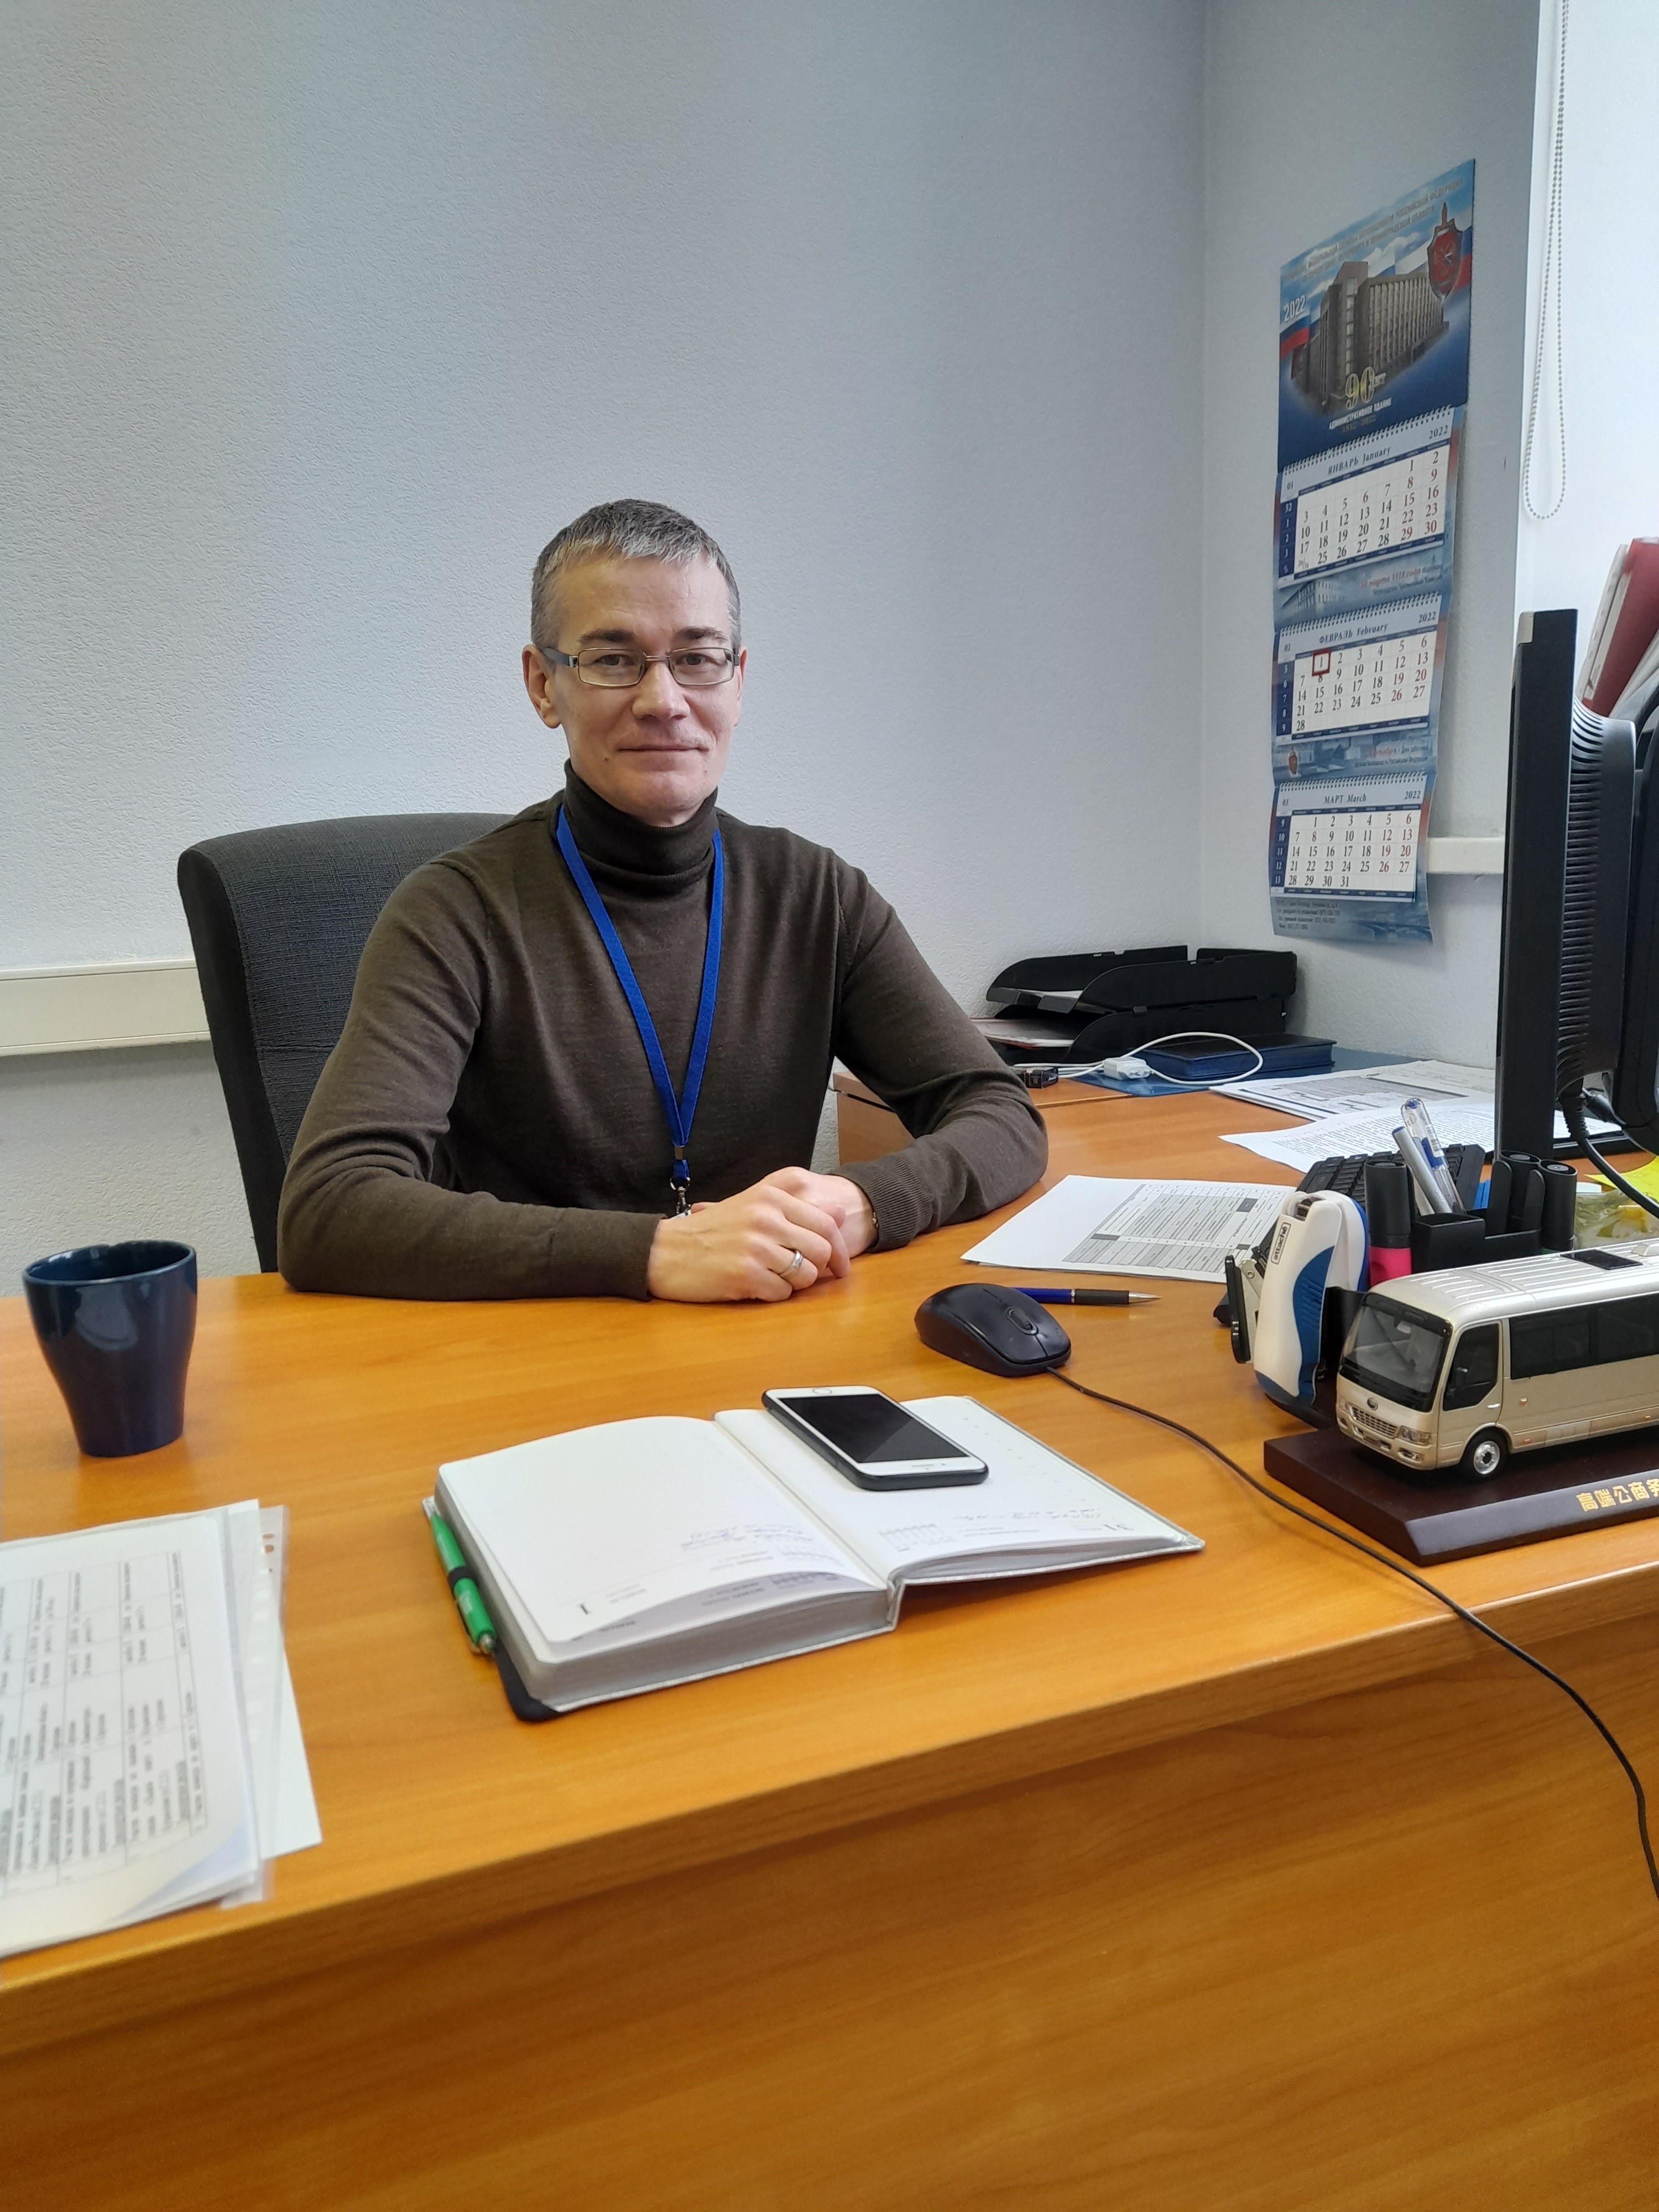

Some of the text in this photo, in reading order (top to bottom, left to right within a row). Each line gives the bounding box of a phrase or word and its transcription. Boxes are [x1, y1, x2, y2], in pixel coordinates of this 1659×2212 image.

[1284, 295, 1306, 321] 2022
[1345, 366, 1375, 410] 90
[1328, 458, 1359, 474] ЯНВАРЬ
[1363, 447, 1392, 463] January
[1429, 425, 1448, 439] 2022
[1410, 460, 1413, 472] 1
[1433, 451, 1438, 464] 2
[1304, 511, 1308, 523] 3
[1323, 505, 1327, 515] 4
[1343, 498, 1347, 510] 5
[1363, 491, 1368, 502] 6
[1385, 483, 1390, 496] 7
[1407, 477, 1413, 488] 8
[1431, 469, 1437, 481] 9
[1302, 526, 1310, 539] 10
[1321, 520, 1328, 533] 11
[1340, 513, 1348, 526] 12
[1361, 507, 1369, 520] 13
[1382, 499, 1391, 513] 14
[1405, 492, 1415, 507] 15
[1428, 485, 1438, 499] 16
[1301, 541, 1309, 554] 17
[1319, 535, 1328, 549] 18
[1338, 530, 1348, 542] 19
[1358, 523, 1369, 536] 20
[1379, 517, 1389, 530] 21
[1402, 509, 1413, 524] 22
[1426, 503, 1437, 517] 23
[1318, 551, 1327, 564] 25
[1337, 545, 1346, 559] 26
[1357, 539, 1367, 553] 27
[1378, 533, 1389, 546] 28
[1401, 526, 1412, 540] 29
[1425, 520, 1437, 534] 30
[1319, 630, 1353, 643] ФЕВРАЛЬ
[1357, 624, 1388, 636] February
[1418, 612, 1436, 623] 2022
[1320, 657, 1323, 667] 1
[1338, 653, 1342, 664] 2
[1358, 649, 1362, 660] 3
[1378, 645, 1383, 656] 4
[1399, 640, 1404, 652] 5
[1421, 636, 1427, 647] 6
[1301, 675, 1305, 686] 7
[1337, 669, 1342, 679] 9
[1354, 664, 1364, 676] 10
[1375, 660, 1383, 672] 11
[1396, 656, 1405, 669] 12
[1418, 651, 1428, 665] 13
[1297, 705, 1305, 716] 21
[1314, 702, 1323, 713] 22
[1332, 698, 1341, 711] 23
[1351, 696, 1360, 707] 24
[1371, 692, 1381, 705] 25
[1391, 689, 1402, 701] 26
[1413, 685, 1425, 698] 27
[1298, 690, 1306, 701] 14
[1316, 687, 1324, 698] 15
[1334, 684, 1343, 695] 16
[1353, 680, 1362, 692] 17
[1373, 676, 1383, 688] 18
[1394, 672, 1404, 685] 19
[1415, 669, 1426, 682] 20
[1297, 720, 1305, 731] 28
[1324, 795, 1344, 804] МАРТ
[1347, 794, 1366, 802] March
[1405, 791, 1420, 800] 2022
[1296, 832, 1300, 842] 7
[1312, 831, 1316, 842] 8
[1329, 831, 1334, 841] 9
[1345, 831, 1354, 841] 10
[1364, 831, 1371, 841] 11
[1383, 830, 1392, 841] 12
[1402, 828, 1412, 841] 13
[1314, 817, 1317, 827] 1
[1331, 816, 1335, 826] 2
[1348, 815, 1353, 826] 3
[1367, 815, 1371, 825] 4
[1386, 813, 1391, 825] 5
[1406, 813, 1411, 824] 6
[1291, 860, 1297, 870] 21
[1307, 860, 1316, 871] 22
[1324, 860, 1333, 872] 23
[1342, 861, 1350, 872] 24
[1360, 861, 1369, 872] 25
[1379, 861, 1389, 872] 26
[1399, 861, 1410, 873] 27
[1292, 847, 1300, 857] 14
[1310, 846, 1317, 857] 15
[1327, 846, 1334, 857] 16
[1344, 846, 1353, 856] 17
[1363, 846, 1371, 857] 18
[1382, 845, 1390, 857] 19
[1400, 845, 1411, 856] 20
[1288, 875, 1297, 885] 28
[1305, 875, 1314, 885] 29
[1323, 876, 1332, 886] 30
[1340, 876, 1348, 887] 31
[1274, 1226, 1287, 1261] attaché
